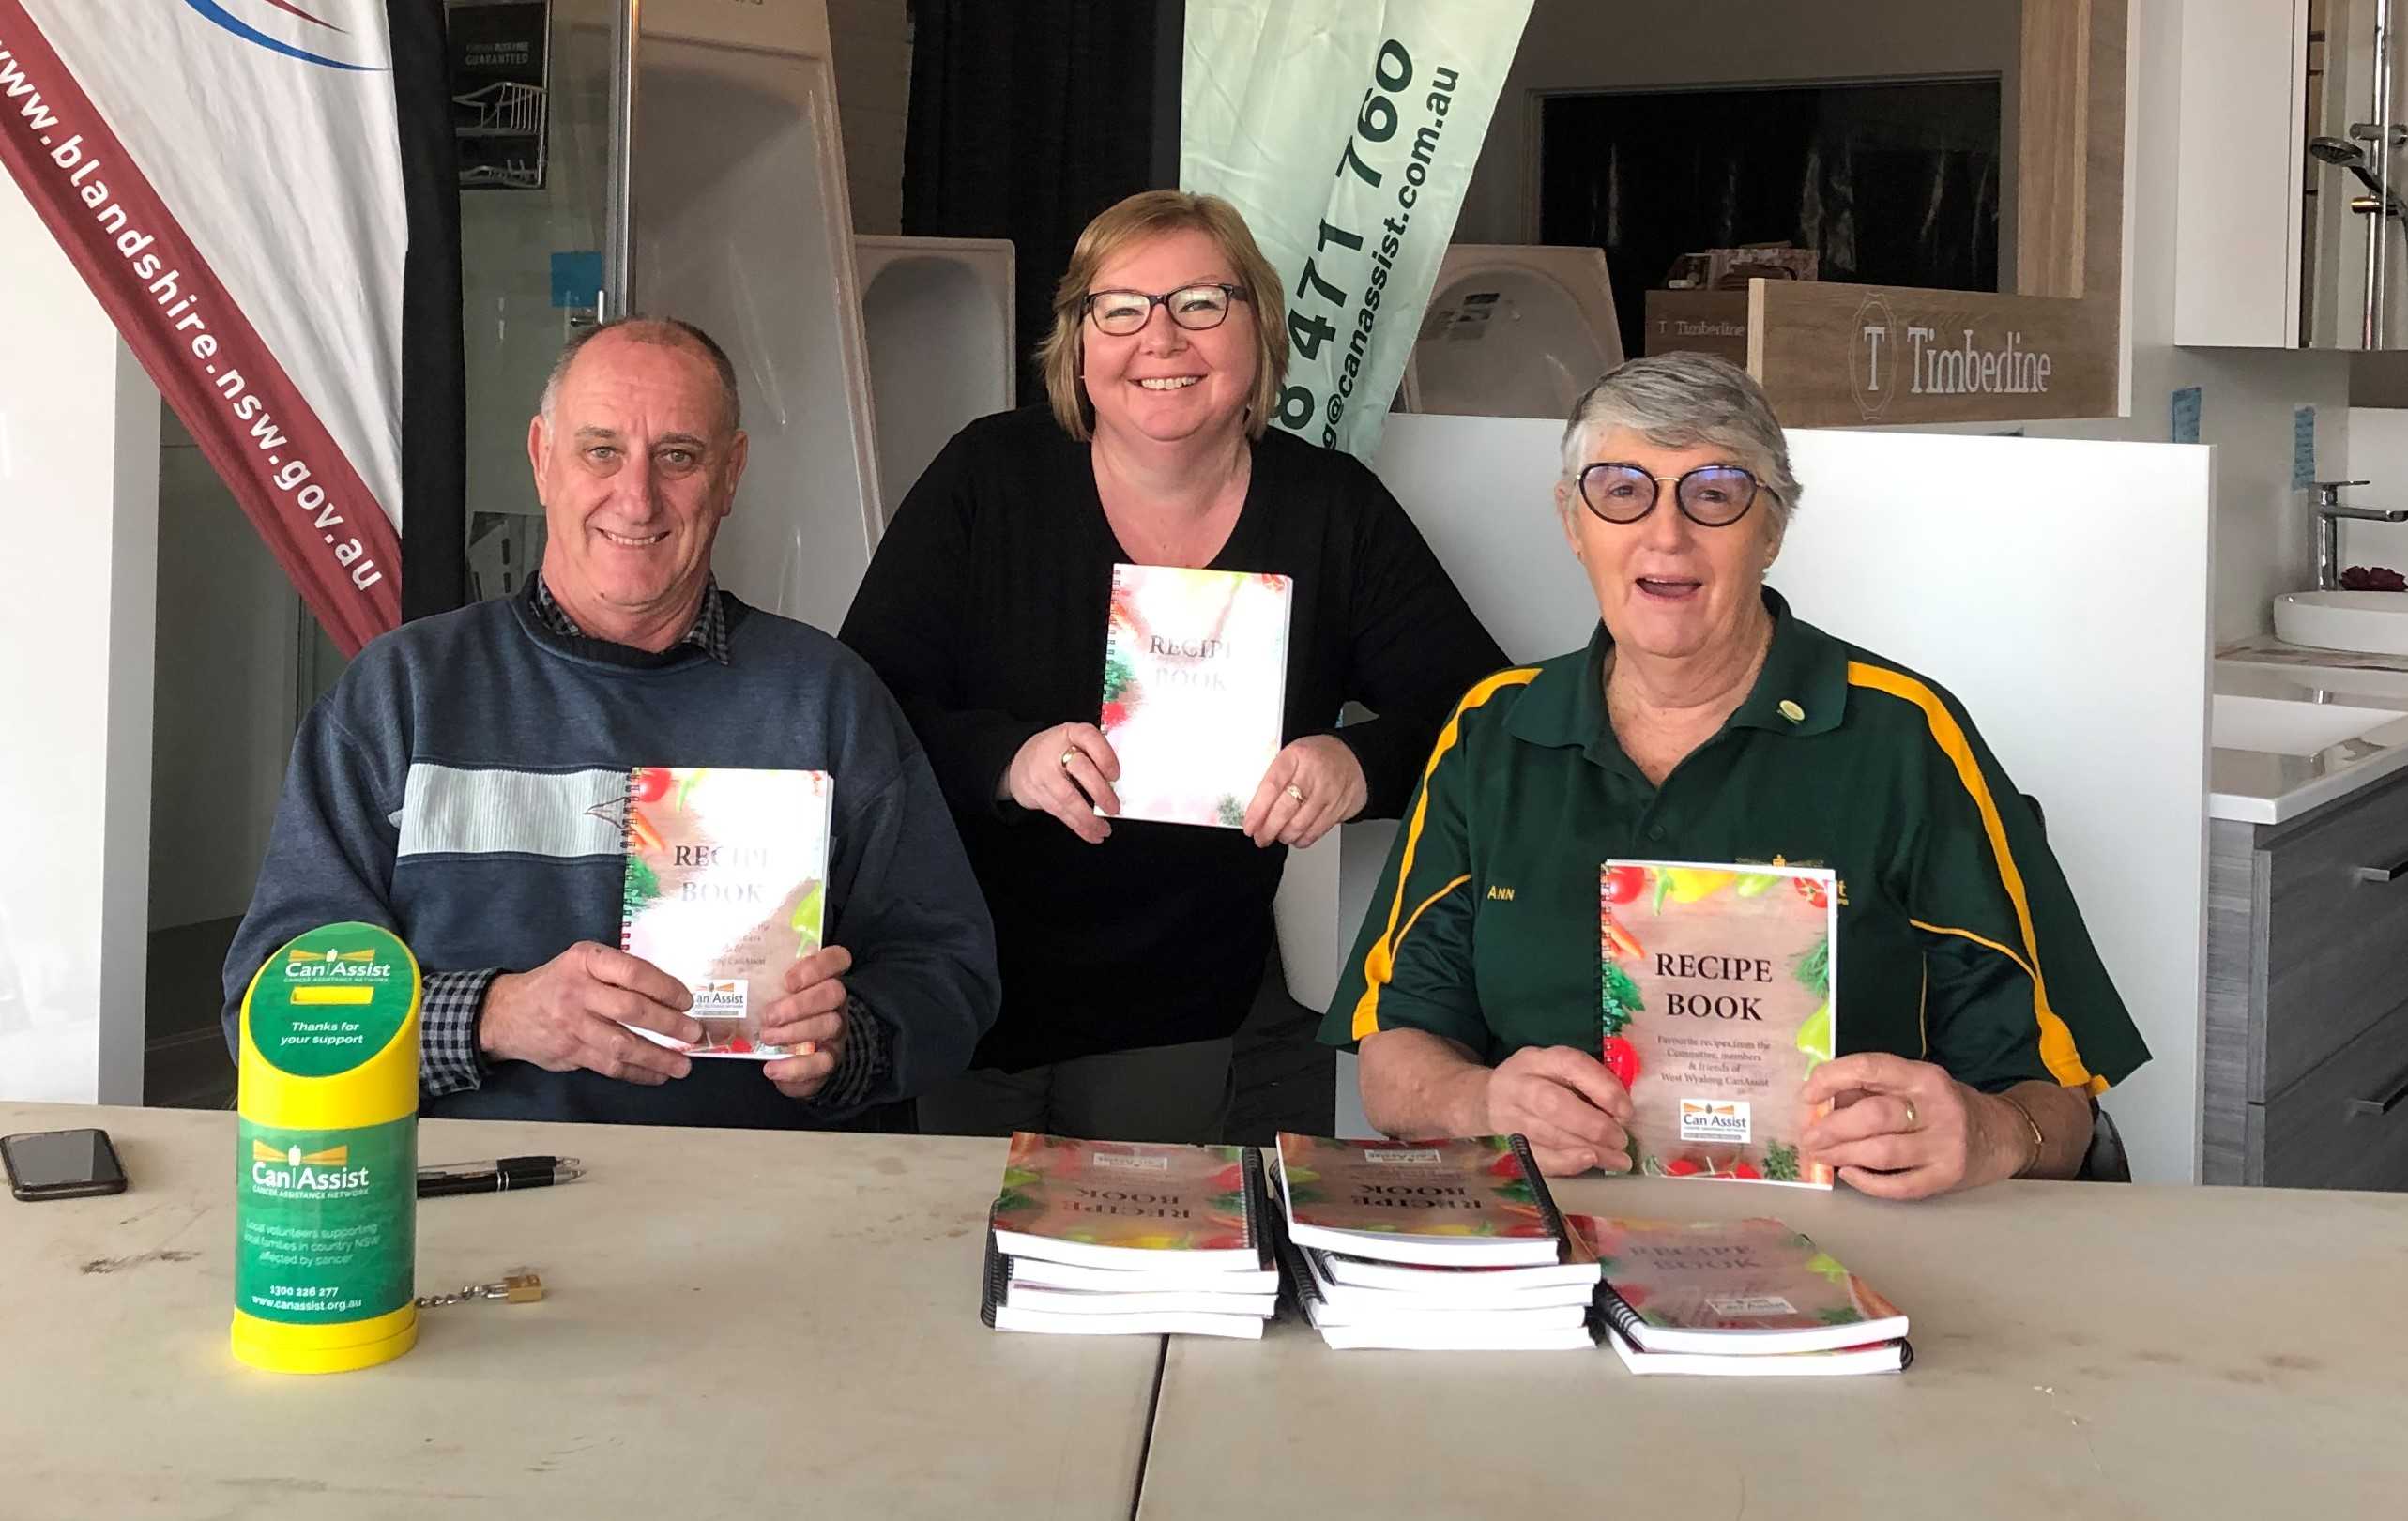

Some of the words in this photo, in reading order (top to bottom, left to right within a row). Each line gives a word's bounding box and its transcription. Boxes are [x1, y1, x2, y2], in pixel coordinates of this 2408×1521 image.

[1288, 218, 1364, 360] 471
[1335, 39, 1412, 188] 760
[1674, 320, 1745, 336] Timberline
[1907, 327, 2051, 394] Timberline
[1487, 885, 1515, 901] ANN
[285, 962, 325, 977] Can
[330, 962, 391, 977] Assist
[1655, 952, 1773, 982] RECIPE
[693, 993, 710, 1004] an
[712, 992, 744, 1004] Assist
[1667, 993, 1762, 1021] BOOK
[293, 1022, 338, 1031] Thanks
[341, 1022, 359, 1031] for
[280, 1036, 311, 1046] your
[312, 1035, 363, 1046] support
[1721, 1052, 1762, 1061] members
[1699, 1062, 1730, 1072] friends
[1731, 1064, 1741, 1072] of
[1661, 1073, 1682, 1082] West
[1684, 1114, 1707, 1126] Can
[1711, 1115, 1746, 1128] Assist
[252, 1161, 290, 1189] Can
[297, 1167, 370, 1190] Assist
[311, 1240, 353, 1252] country
[299, 1255, 312, 1267] by
[269, 1285, 294, 1296] 1300
[319, 1287, 339, 1297] 277
[251, 1295, 362, 1311] www.canassist.org.au
